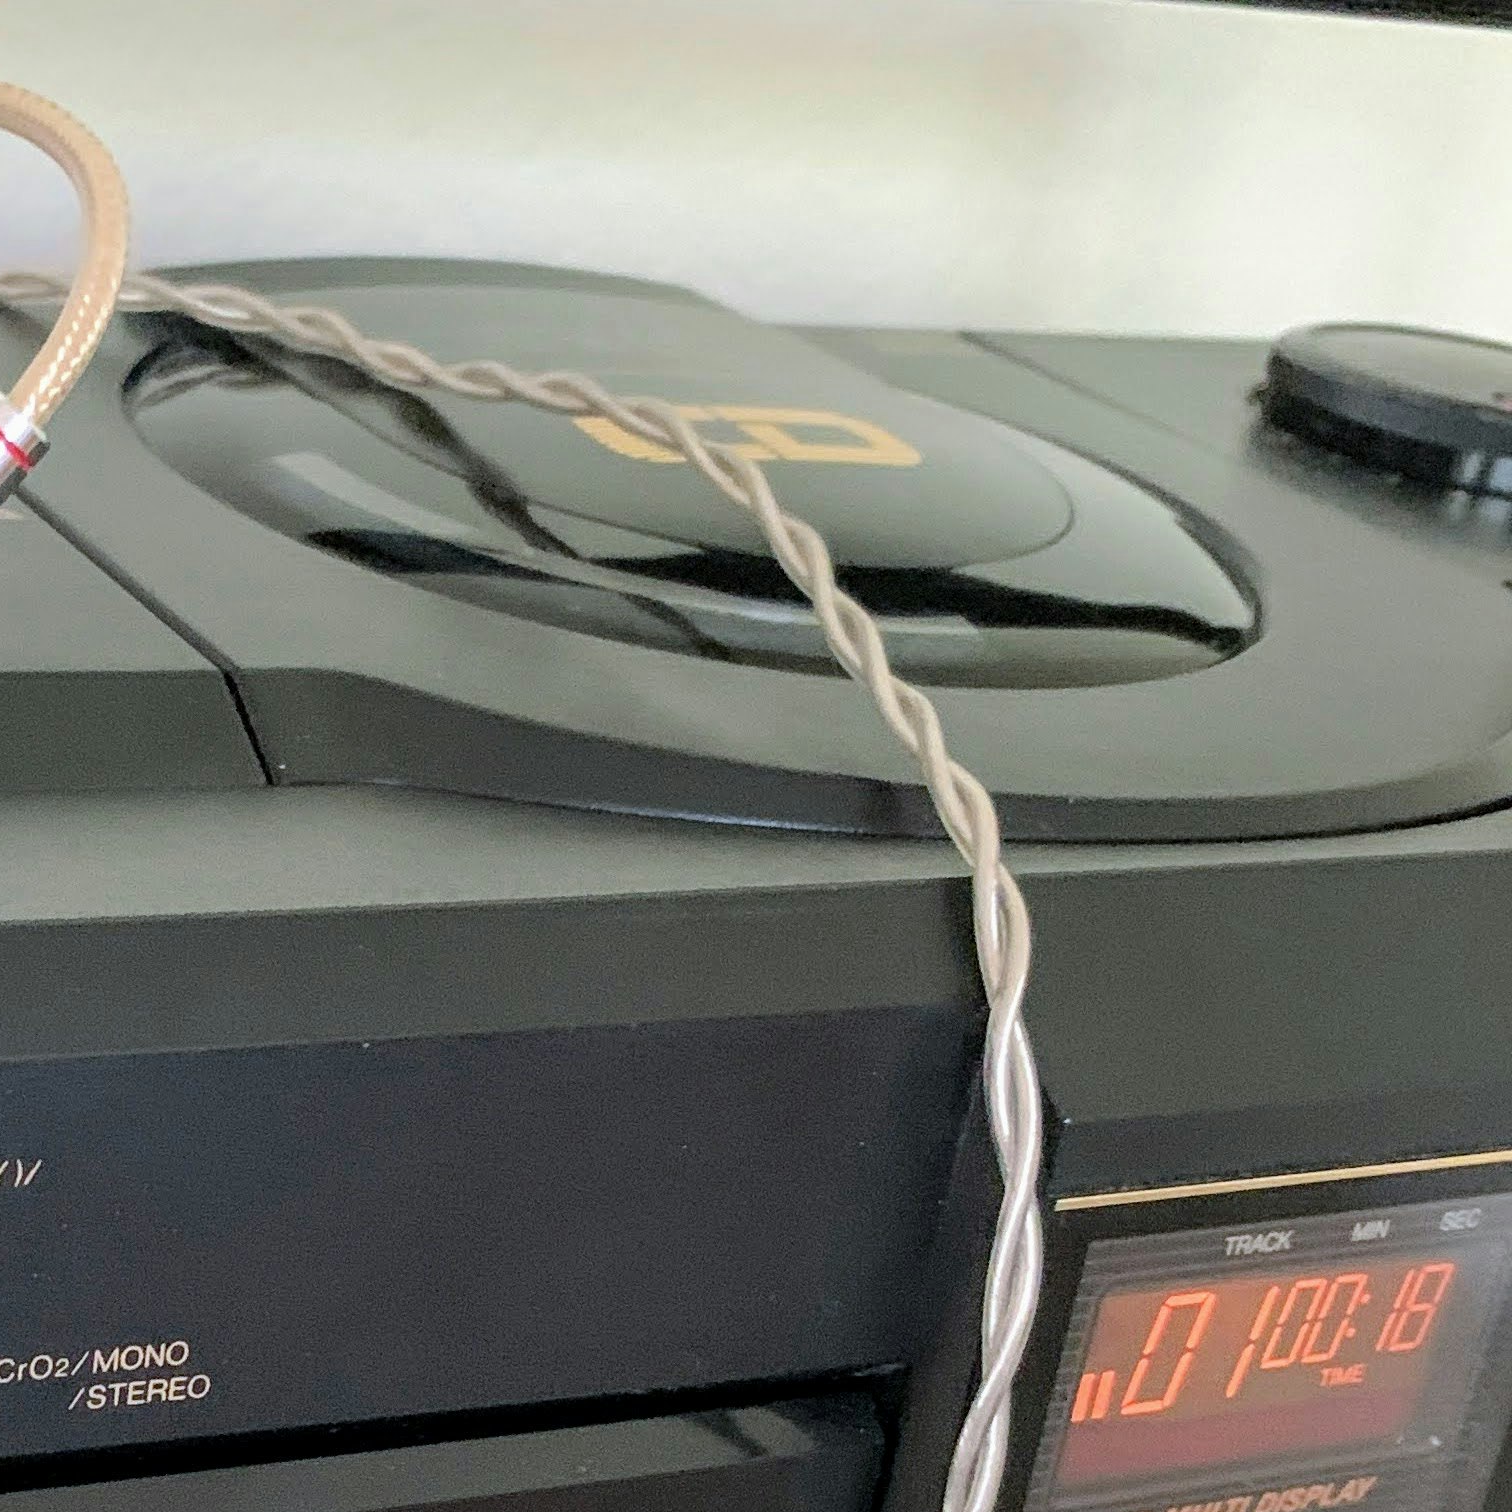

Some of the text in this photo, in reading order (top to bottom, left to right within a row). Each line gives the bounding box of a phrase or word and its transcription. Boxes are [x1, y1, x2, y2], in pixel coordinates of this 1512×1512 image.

[1351, 1219, 1390, 1242] MIN
[1225, 1230, 1294, 1256] TRACK
[1320, 1363, 1366, 1387] TIME
